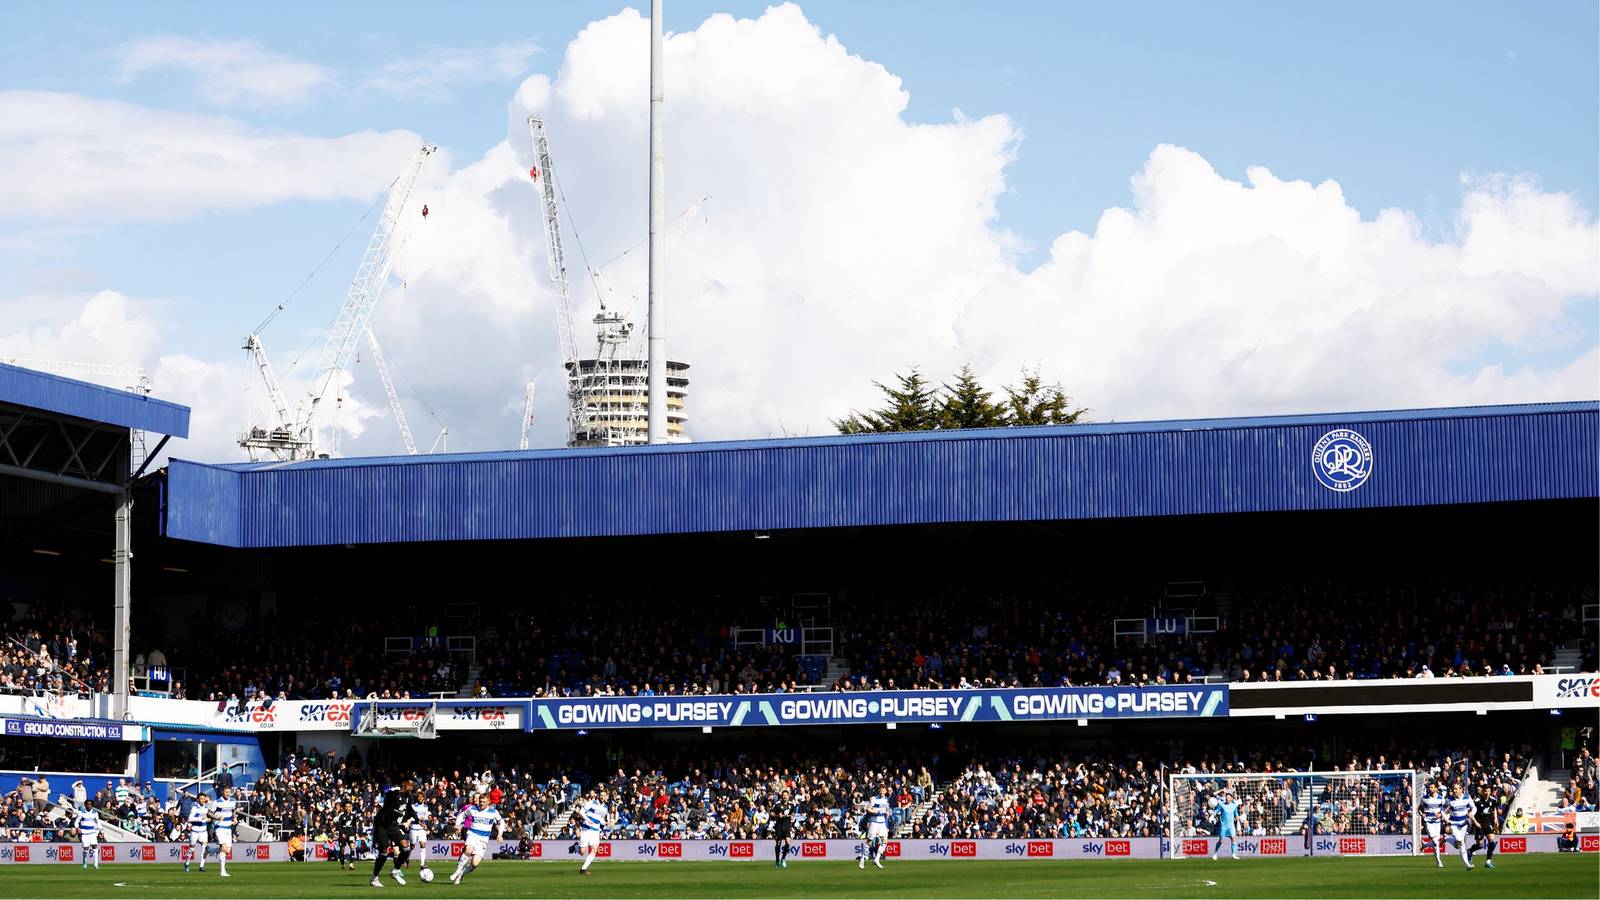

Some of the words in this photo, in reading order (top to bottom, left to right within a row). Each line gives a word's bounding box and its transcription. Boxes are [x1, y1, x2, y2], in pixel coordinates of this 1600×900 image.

[1315, 436, 1331, 463] QUEENS
[1331, 431, 1349, 439] PARK
[1350, 433, 1370, 461] RANGERS
[1156, 618, 1176, 633] LU
[772, 629, 794, 643] KU
[154, 666, 166, 680] HU
[1556, 678, 1600, 697] SKYE
[781, 699, 867, 720] GOWING
[881, 697, 962, 717] PURSEY
[1013, 693, 1103, 715] GOWING
[1118, 691, 1203, 711] PURSEY
[558, 703, 641, 724] GOWING
[654, 702, 732, 721] PURSEY
[8, 721, 21, 731] GCL
[24, 723, 54, 735] GROUND
[55, 724, 107, 737] CONSTRUCTION
[108, 727, 120, 736] GCL
[432, 843, 449, 856] sky
[709, 844, 728, 856] sky
[731, 844, 751, 854] bet
[804, 844, 824, 854] bet
[886, 845, 898, 854] et
[929, 843, 949, 855] sky
[954, 843, 975, 854] bet
[1005, 842, 1025, 855] sky
[1030, 843, 1050, 853] bet
[1083, 841, 1103, 855] sky
[1107, 842, 1128, 852] bet
[1238, 840, 1258, 854] sky
[1262, 841, 1283, 851] bet
[1316, 839, 1337, 853] sky
[1341, 840, 1363, 850] bet
[1502, 840, 1524, 850] bet
[1584, 838, 1599, 848] be
[1, 846, 13, 860] sky
[15, 847, 29, 858] bet
[46, 846, 58, 860] sky
[60, 847, 72, 857] bet
[102, 847, 114, 857] bet
[130, 845, 141, 860] sky
[143, 846, 155, 857] bet
[170, 845, 180, 859] sky
[246, 845, 256, 859] sky
[258, 846, 269, 857] bet
[638, 844, 656, 857] sky
[660, 844, 679, 854] bet
